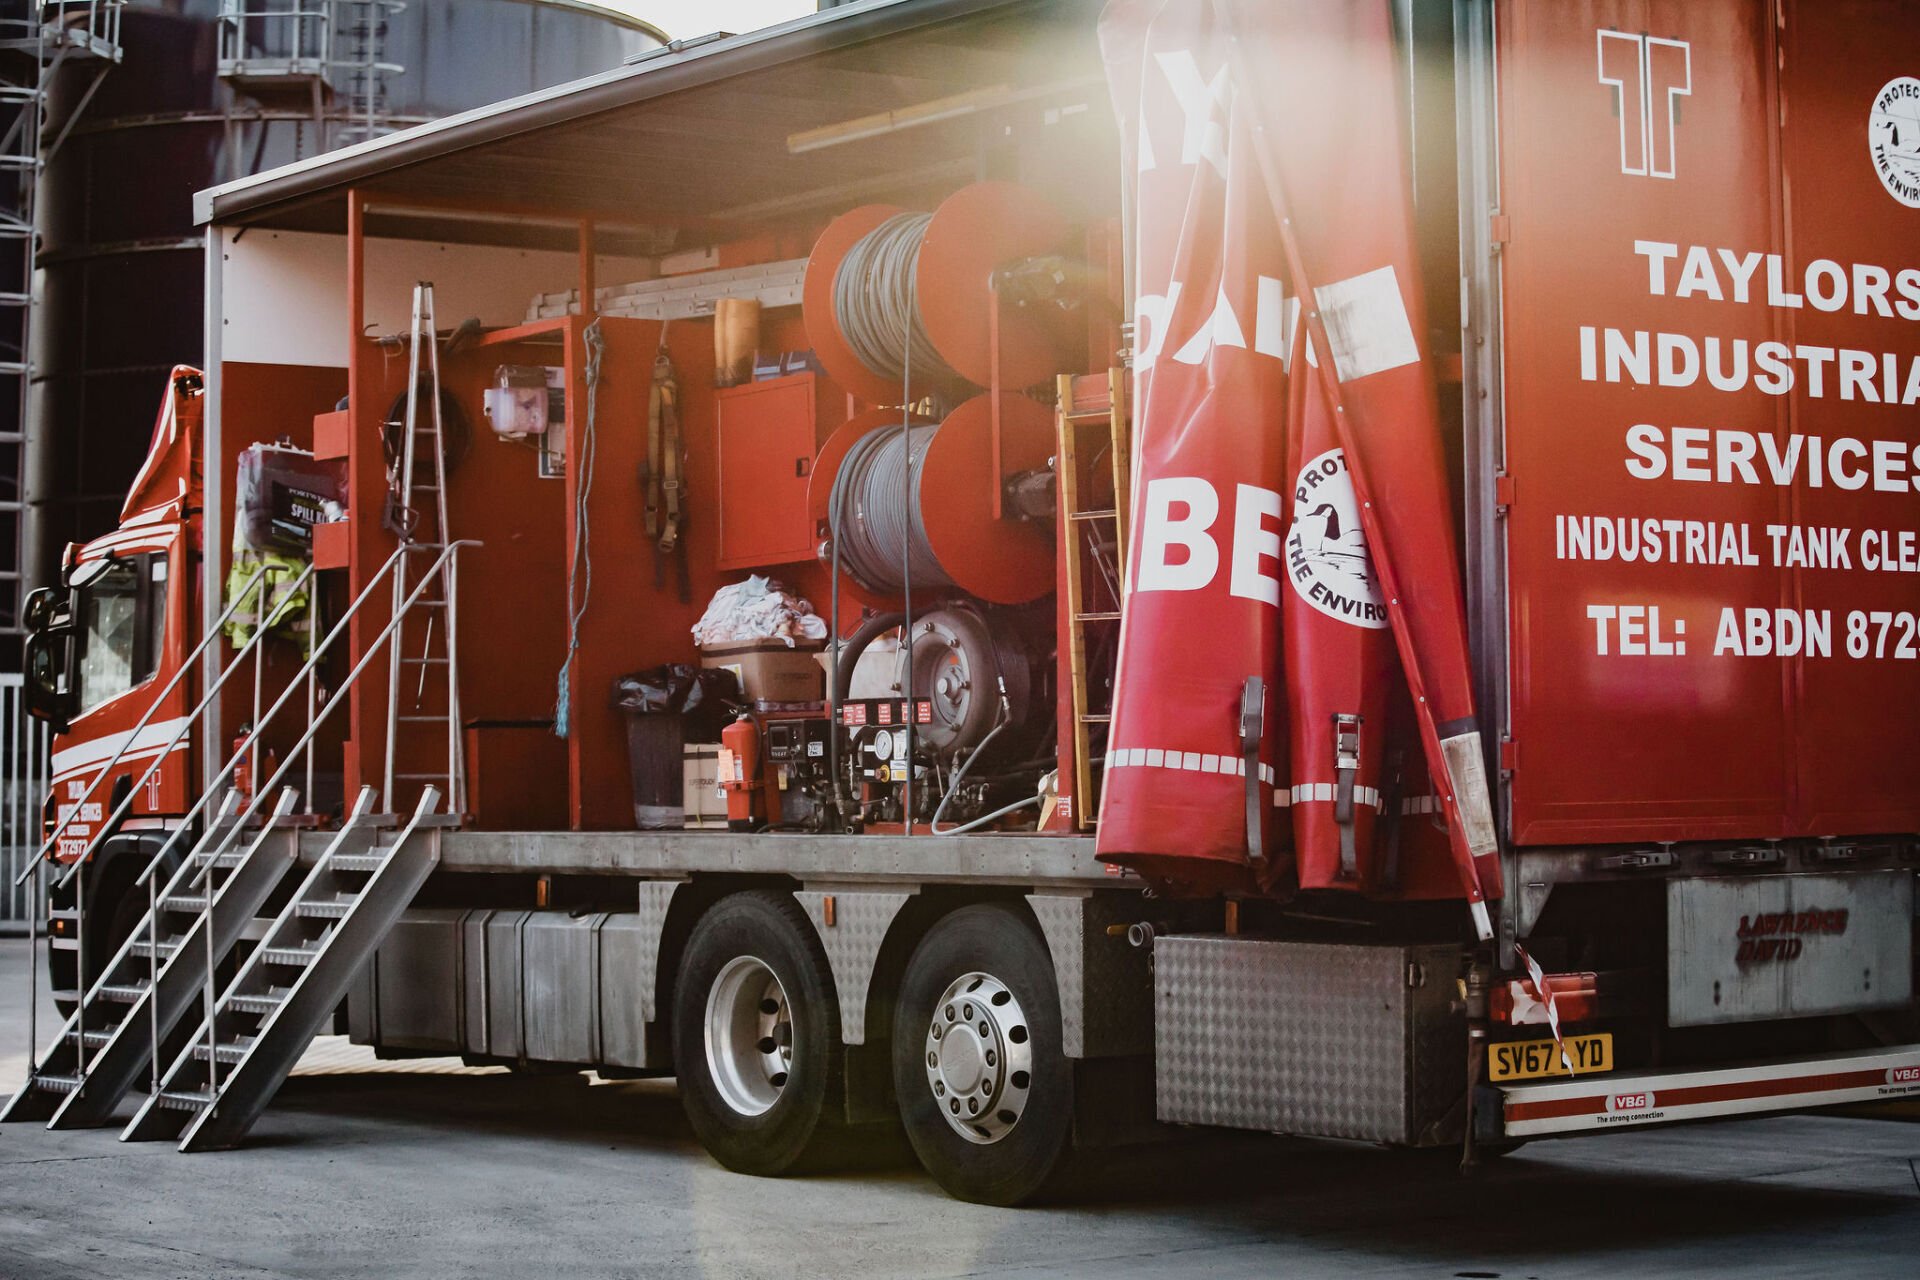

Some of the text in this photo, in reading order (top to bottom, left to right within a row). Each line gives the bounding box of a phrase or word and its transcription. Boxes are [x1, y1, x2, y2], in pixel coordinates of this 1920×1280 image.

[1875, 144, 1890, 174] THE
[1634, 240, 1920, 321] TAYLORS
[1624, 424, 1920, 493] SERVICE
[291, 503, 314, 522] SPILL
[1137, 477, 1282, 608] BE
[1289, 533, 1313, 583] THE
[1556, 514, 1920, 572] INDUSTRIAL TANK CLE
[1587, 605, 1920, 659] TEL: ABDN 872
[1498, 1043, 1553, 1075] SV67
[1895, 1068, 1920, 1080] VBG
[1609, 1114, 1630, 1122] strong
[1631, 1111, 1664, 1120] connection
[1616, 1095, 1645, 1108] VBG
